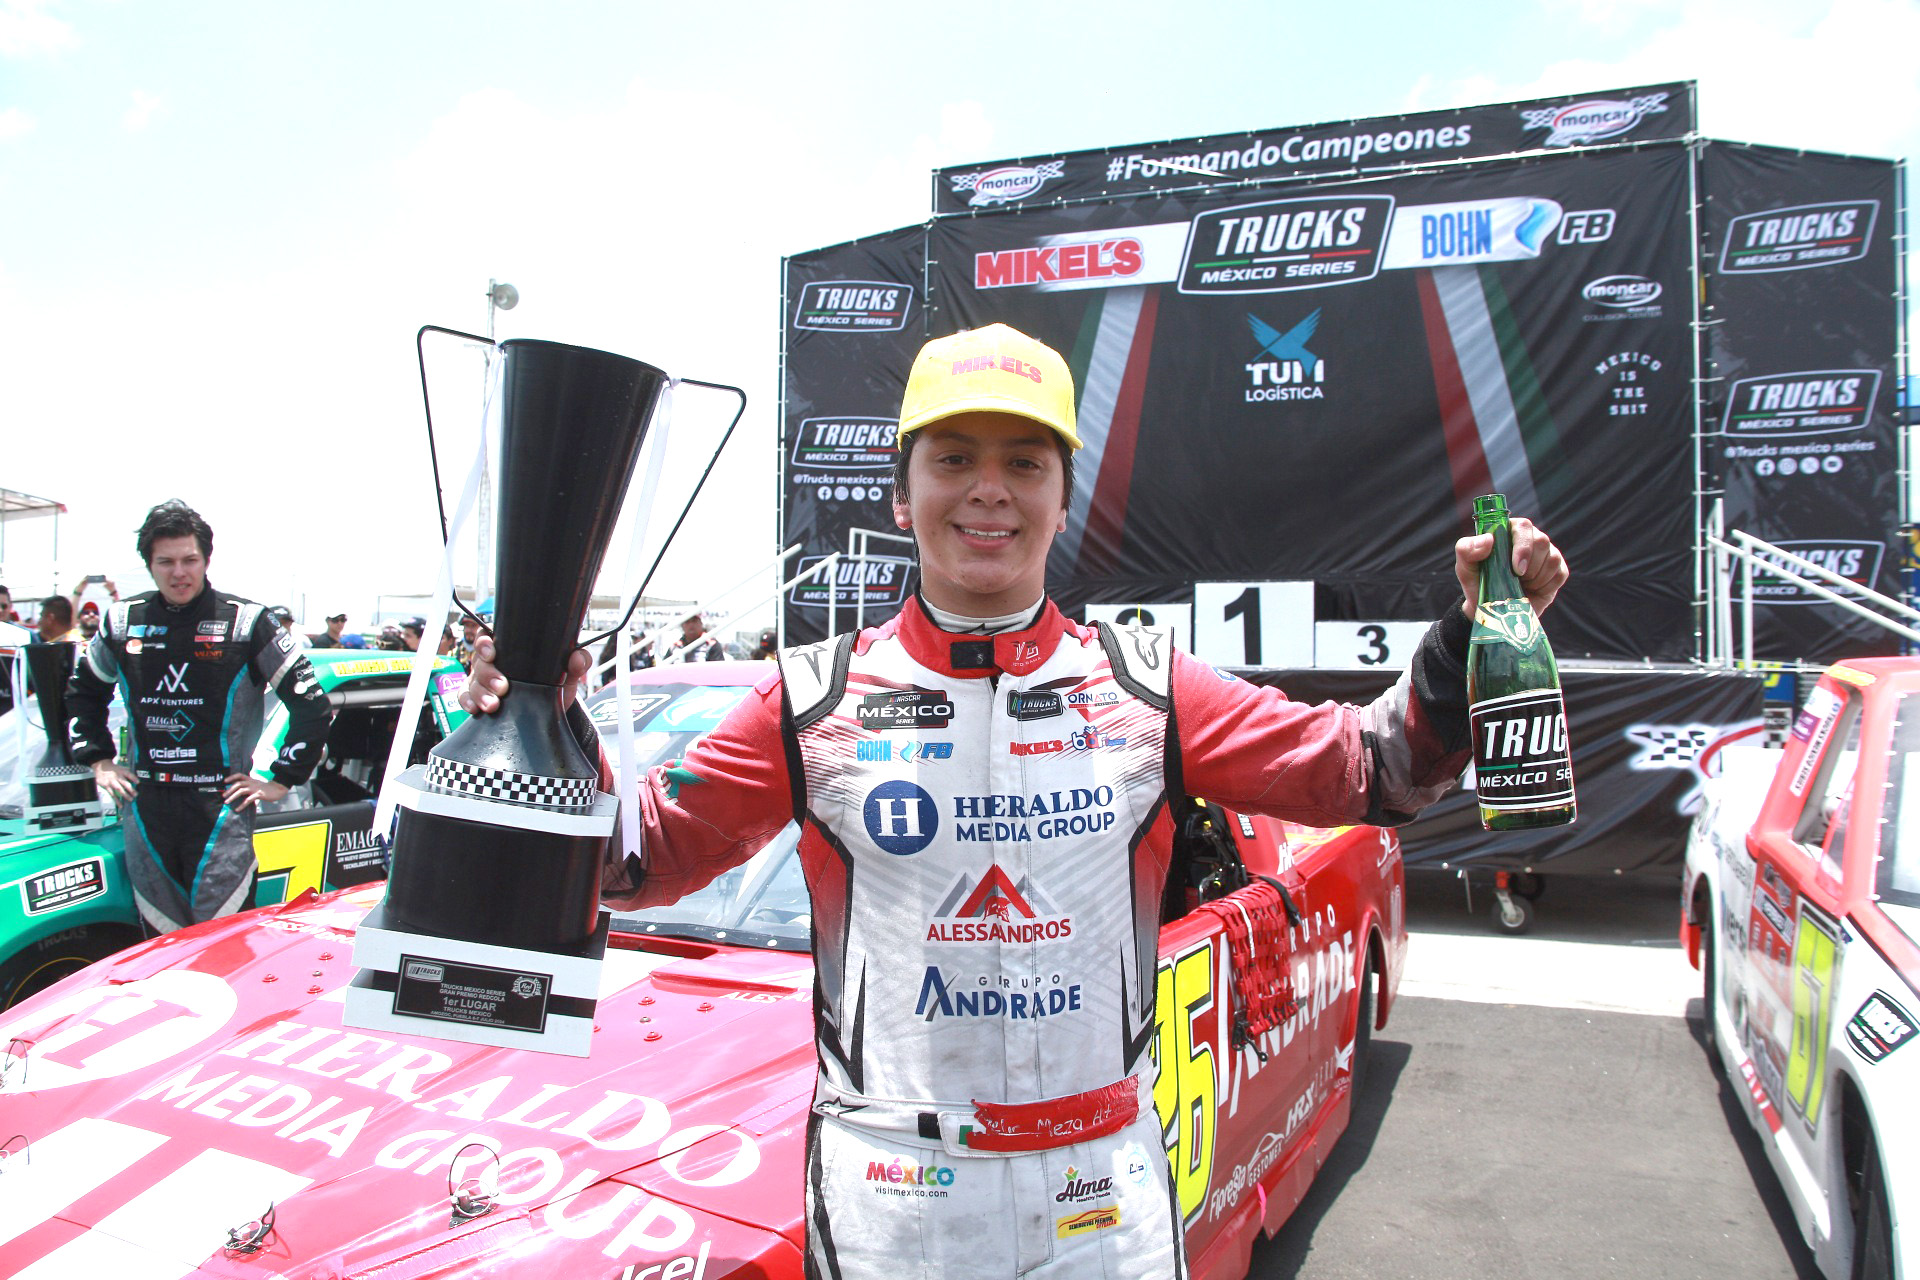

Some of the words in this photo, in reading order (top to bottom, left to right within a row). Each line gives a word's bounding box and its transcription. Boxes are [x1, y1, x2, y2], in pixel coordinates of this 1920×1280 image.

[1561, 110, 1629, 127] moncar
[1106, 124, 1471, 182] #FormandoCampeones
[981, 174, 1034, 190] moncar
[1216, 207, 1366, 256] TRUCKS
[1422, 209, 1491, 259] BOHN
[1559, 211, 1614, 243] FB
[1746, 209, 1859, 248] TRUCKS
[1797, 246, 1852, 261] SERIES
[1201, 266, 1277, 284] MÉXICO
[1285, 261, 1356, 278] SERIES
[1590, 282, 1656, 298] moncar
[816, 288, 898, 310] TRUCKS
[854, 317, 893, 326] SERIES
[1595, 352, 1662, 374] MEXICO
[1620, 371, 1637, 381] IS
[1245, 385, 1324, 402] LOGÍSTICA
[1613, 387, 1645, 399] THE
[1748, 378, 1861, 411] TRUCKS
[1610, 404, 1648, 415] SHIT
[1799, 415, 1854, 427] SERIES
[814, 424, 898, 446] TRUCKS
[1833, 439, 1876, 452] series
[852, 454, 891, 462] SERIES
[836, 474, 875, 484] mexico
[803, 591, 847, 600] MÉXCO
[851, 592, 890, 600] SRIES
[1224, 587, 1262, 665] 1
[1356, 625, 1389, 665] 3
[140, 697, 160, 705] APX
[161, 698, 204, 706] VENTURES
[896, 694, 921, 703] NASCAR
[1022, 697, 1058, 709] TRUCKS
[859, 704, 951, 718] MÉXICO
[146, 716, 179, 725] EMAGAS
[857, 740, 892, 761] BOHN
[921, 742, 954, 759] FB
[1010, 740, 1064, 757] MKEL'S
[1480, 772, 1547, 788] MÉXICO
[953, 785, 1114, 818] HERALDO
[875, 798, 925, 837] H
[956, 821, 1031, 842] MEDIA
[1037, 811, 1115, 840] GROUP
[34, 864, 94, 896] TRUCKS
[926, 918, 1071, 944] ALESSANDROS
[1289, 904, 1336, 952] RUPO
[441, 983, 463, 992] TRUCKS
[463, 986, 485, 994] MEXICO
[486, 989, 506, 997] SERIES
[978, 974, 1060, 989] GRUPO
[439, 988, 456, 997] GRAN
[457, 991, 477, 999] PREMIO
[478, 993, 506, 1002] REDCOLA
[915, 965, 1081, 1022] ANDRADE
[443, 996, 458, 1006] 1er
[460, 999, 497, 1012] LUGAR
[444, 1006, 467, 1014] TRUCKS
[469, 1009, 492, 1017] MEXICO
[217, 1021, 761, 1188] HERALDO
[138, 1064, 374, 1158] MEDIA
[375, 1130, 695, 1260] GROUP
[875, 1186, 948, 1198] visitmexico.com
[1056, 1178, 1113, 1202] Alma
